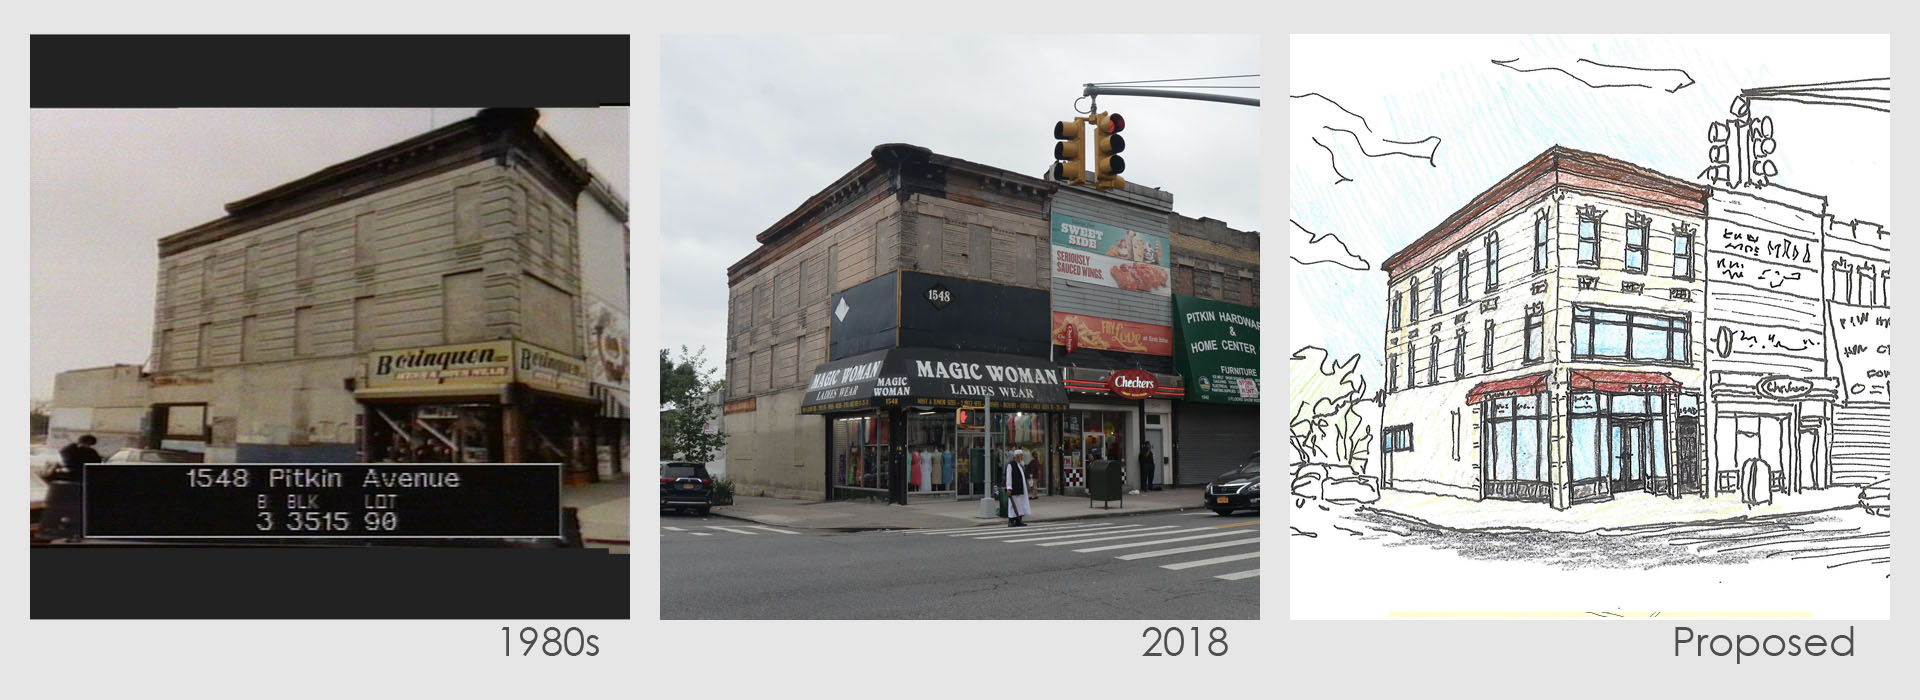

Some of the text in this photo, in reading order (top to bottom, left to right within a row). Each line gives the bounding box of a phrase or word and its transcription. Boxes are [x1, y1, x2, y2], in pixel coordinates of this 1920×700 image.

[1061, 223, 1104, 240] SWEET
[1069, 235, 1097, 249] SIDE
[1057, 250, 1090, 266] SERIOUSLY
[1057, 262, 1104, 280] SAUCED WINGS.
[928, 289, 951, 302] 1548
[1186, 311, 1215, 324] PITKIN
[1229, 326, 1237, 337] &
[1191, 340, 1257, 355] HOME CENTER
[813, 360, 881, 389] MAGIC WOMAN
[916, 360, 1058, 385] MAGIC WOMAN
[1220, 365, 1258, 377] FURNITURE
[877, 376, 908, 386] MAGIC
[1114, 375, 1154, 389] Checkers
[816, 385, 858, 400] LADIES WEAR
[873, 386, 910, 397] WOMAN
[950, 383, 1034, 399] LADIES WEAR
